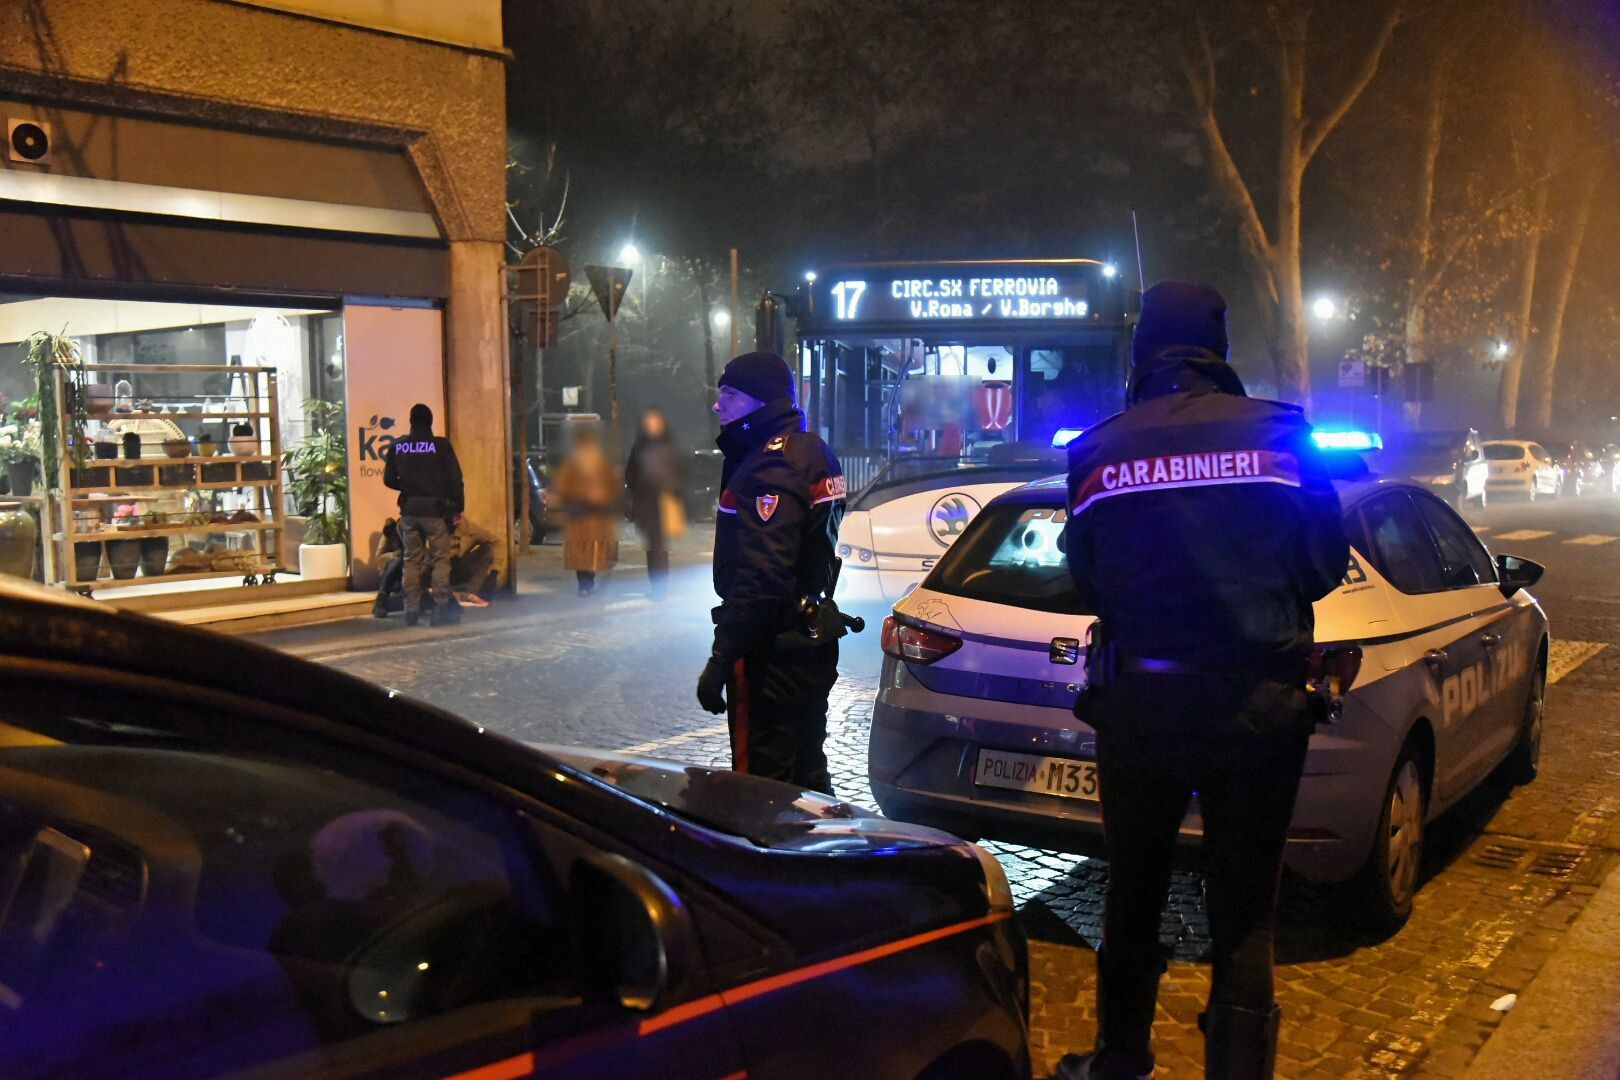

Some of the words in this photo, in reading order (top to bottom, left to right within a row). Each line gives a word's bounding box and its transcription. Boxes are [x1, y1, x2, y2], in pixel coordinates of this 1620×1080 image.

[831, 280, 866, 319] 17
[892, 280, 963, 298] CIRC.SX
[970, 278, 1058, 296] FERROVIA
[911, 300, 973, 317] V.Roma
[1001, 298, 1088, 318] V.Borghe
[359, 427, 394, 462] ka
[396, 442, 437, 454] POLIZIA
[360, 465, 384, 477] flow
[1102, 452, 1260, 490] CARABINIERI
[983, 758, 1037, 783] POLIZIA
[1046, 761, 1097, 795] M33
